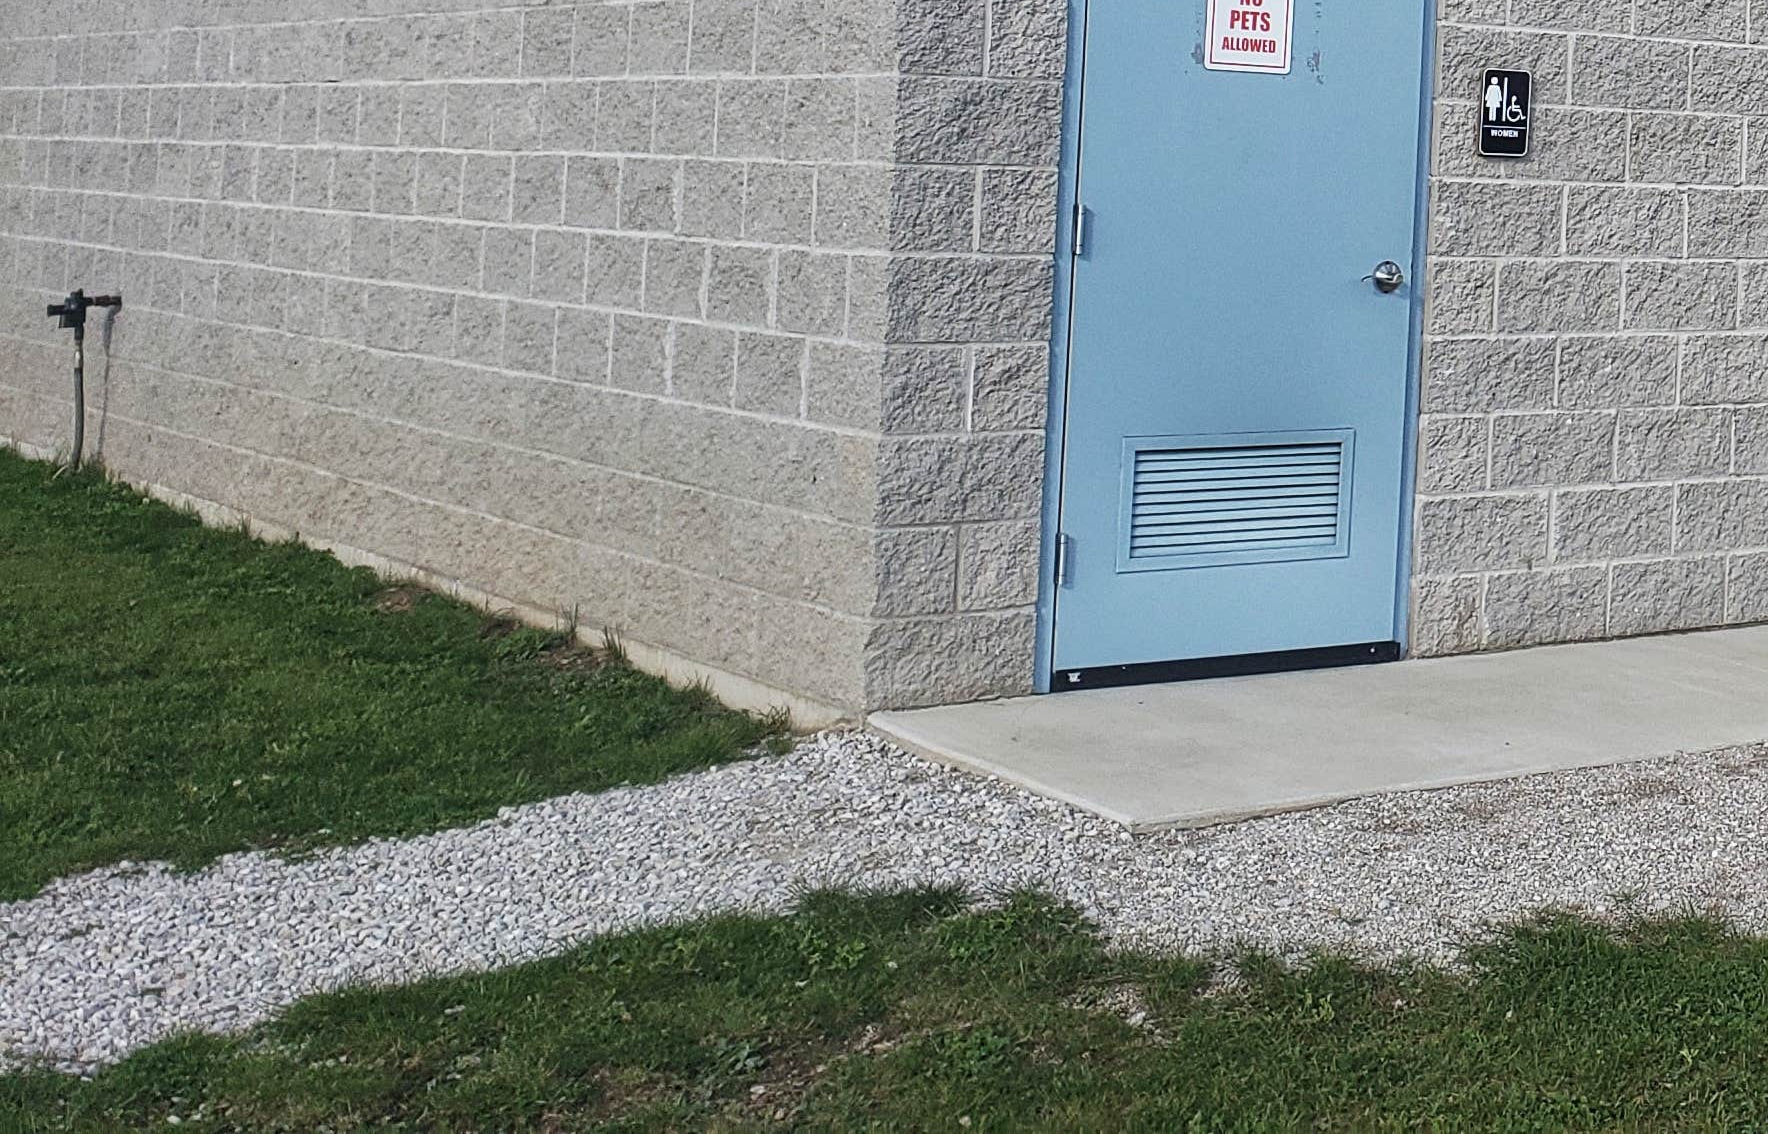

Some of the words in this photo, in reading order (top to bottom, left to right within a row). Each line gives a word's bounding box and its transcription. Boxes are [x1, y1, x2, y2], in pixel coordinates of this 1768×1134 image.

[1229, 9, 1271, 32] PETS
[1221, 36, 1276, 53] ALLOWED
[1490, 129, 1518, 137] WOMEN
